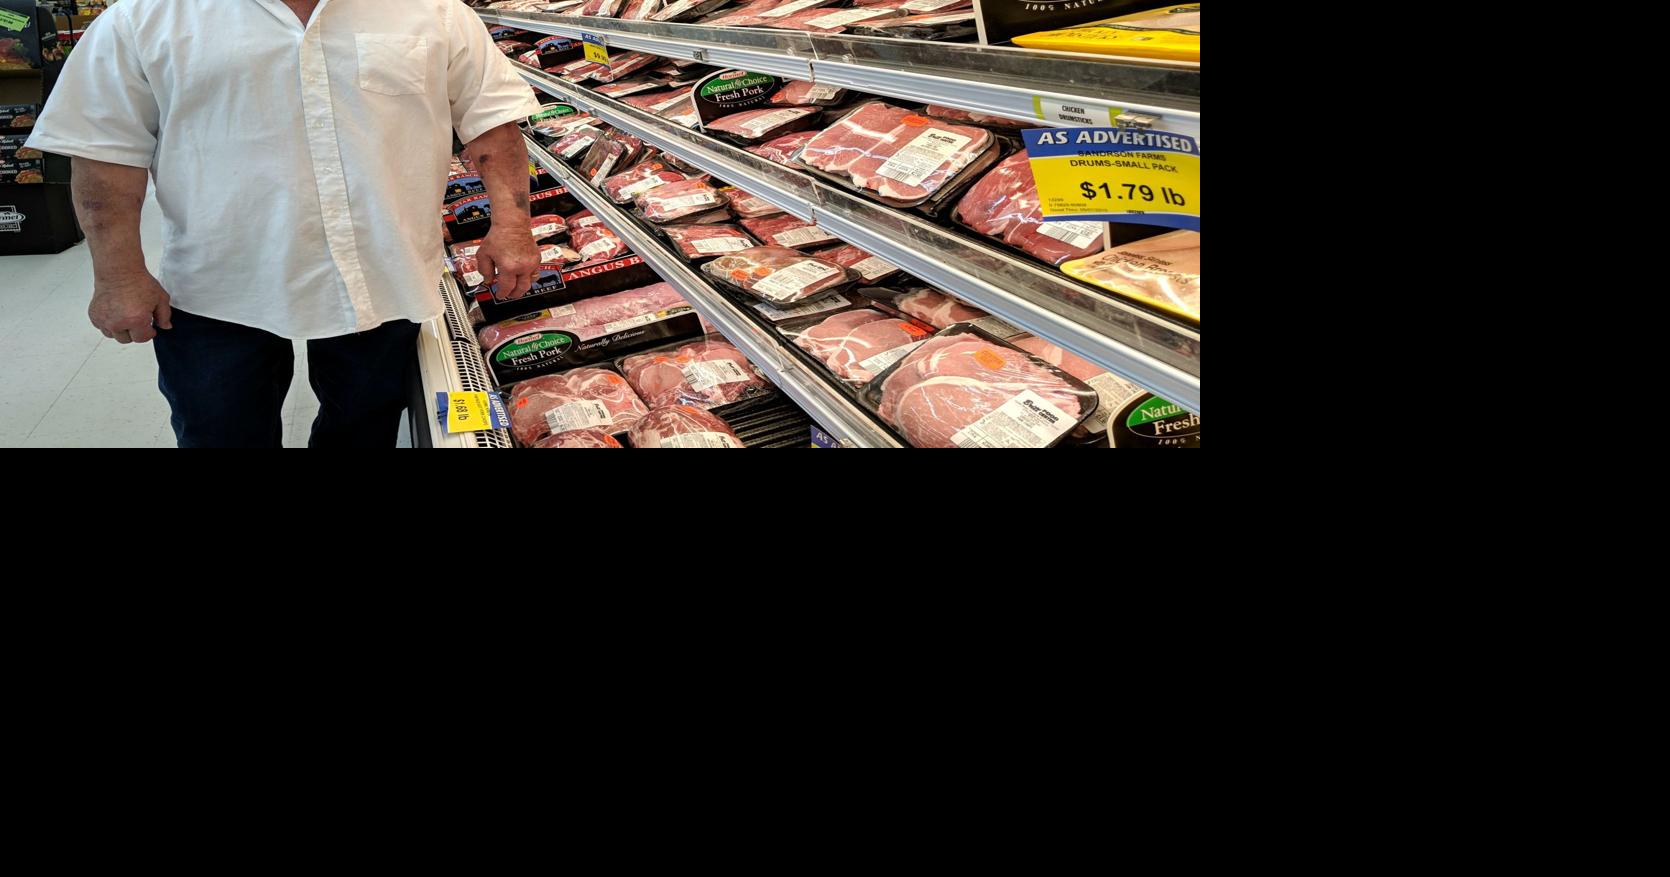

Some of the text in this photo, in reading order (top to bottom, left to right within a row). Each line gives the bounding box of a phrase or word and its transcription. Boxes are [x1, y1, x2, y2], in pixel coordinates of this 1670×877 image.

[706, 76, 767, 94] Natural Choice
[715, 85, 764, 102] Fresh Pork
[1062, 105, 1085, 114] CHICKEN
[1058, 114, 1093, 125] DRUMSTICKS
[1037, 130, 1192, 152] AS ADVERTISED
[1069, 159, 1178, 173] DRUMS-SMALL PACK
[1135, 152, 1167, 162] FARMS
[1080, 181, 1186, 207] $1.79 lb
[568, 261, 624, 281] ANGUS
[502, 337, 565, 359] Natural Choice
[517, 334, 541, 344] Hormel
[576, 329, 645, 352] Naturally Delicious
[511, 346, 562, 366] Fresh Pork
[1152, 413, 1200, 435] Fresh
[816, 432, 828, 444] AS
